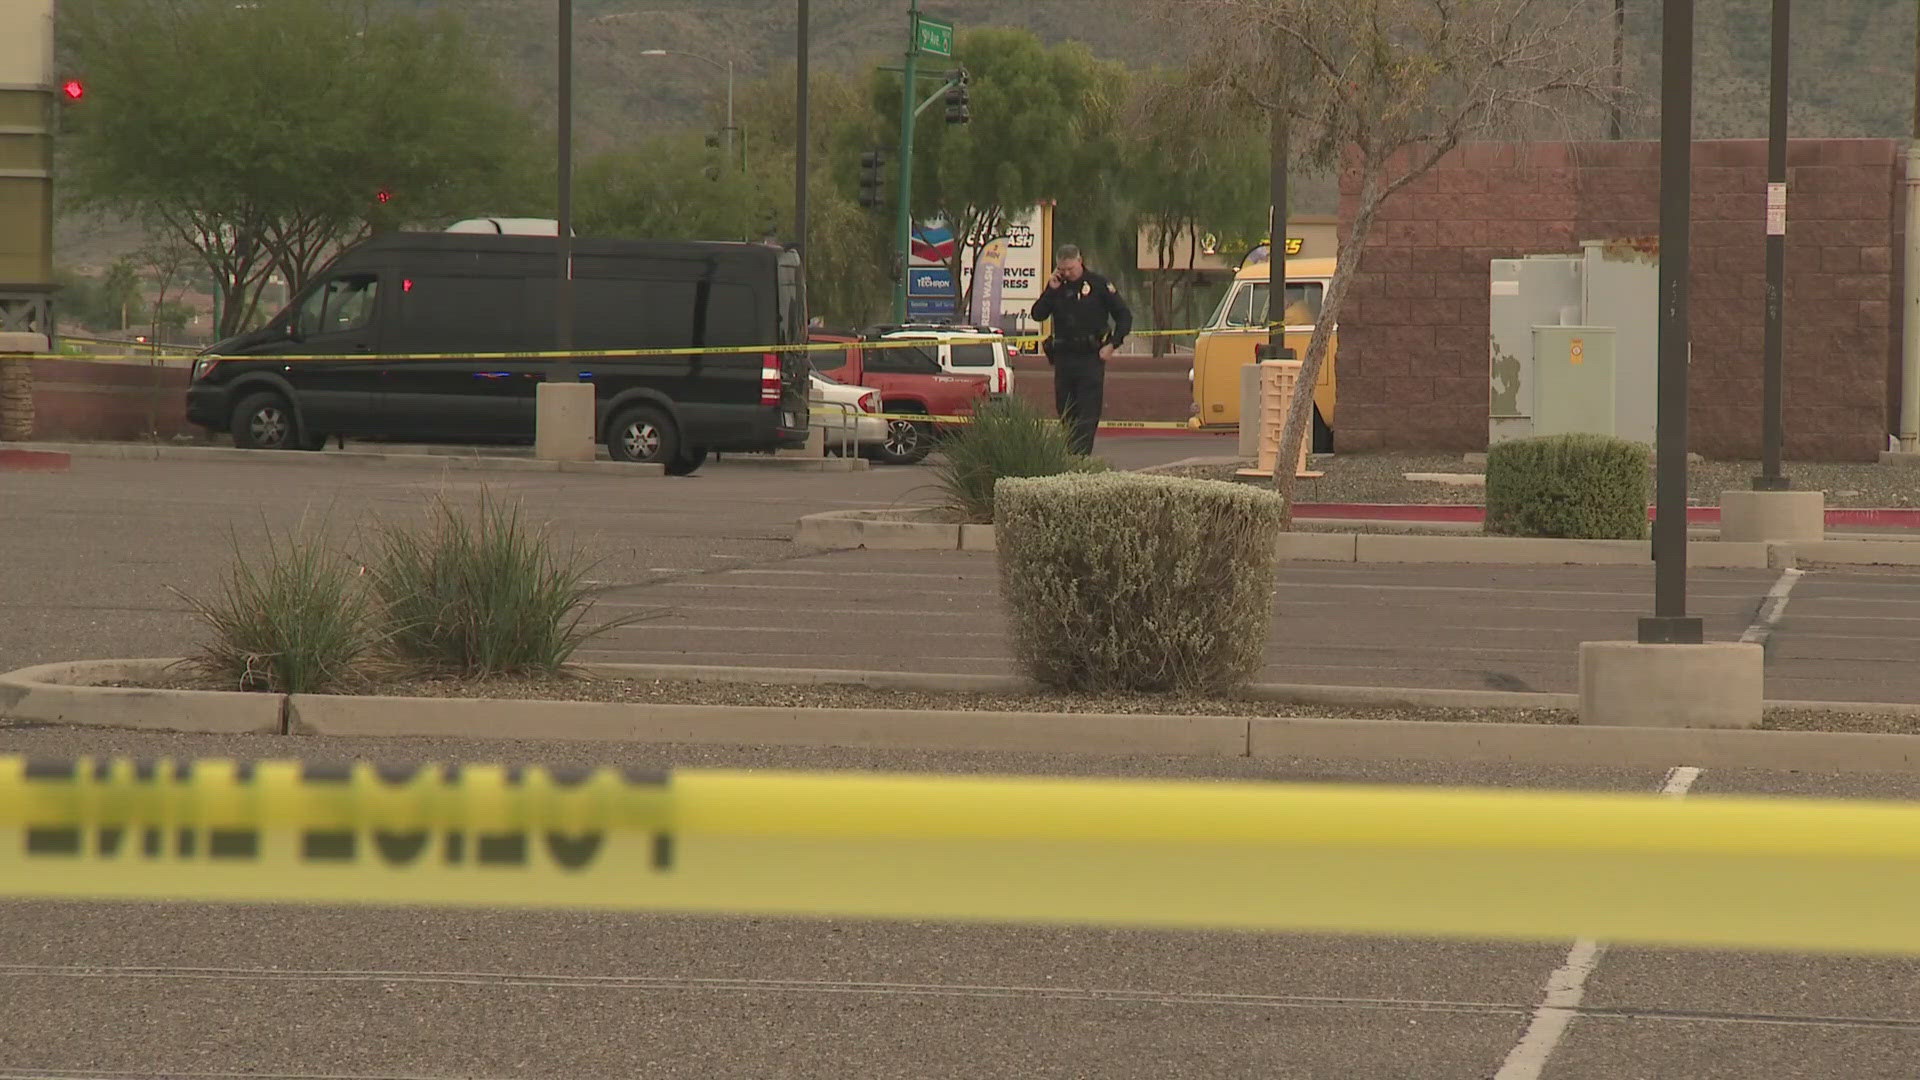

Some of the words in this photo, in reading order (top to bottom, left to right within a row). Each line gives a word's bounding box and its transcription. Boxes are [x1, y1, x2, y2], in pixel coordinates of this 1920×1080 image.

[1008, 234, 1034, 247] ASH
[1003, 268, 1035, 277] RVICE
[917, 279, 951, 289] TECHRON
[983, 265, 994, 299] WASH
[1002, 280, 1029, 288] RESS
[981, 299, 991, 326] RESS
